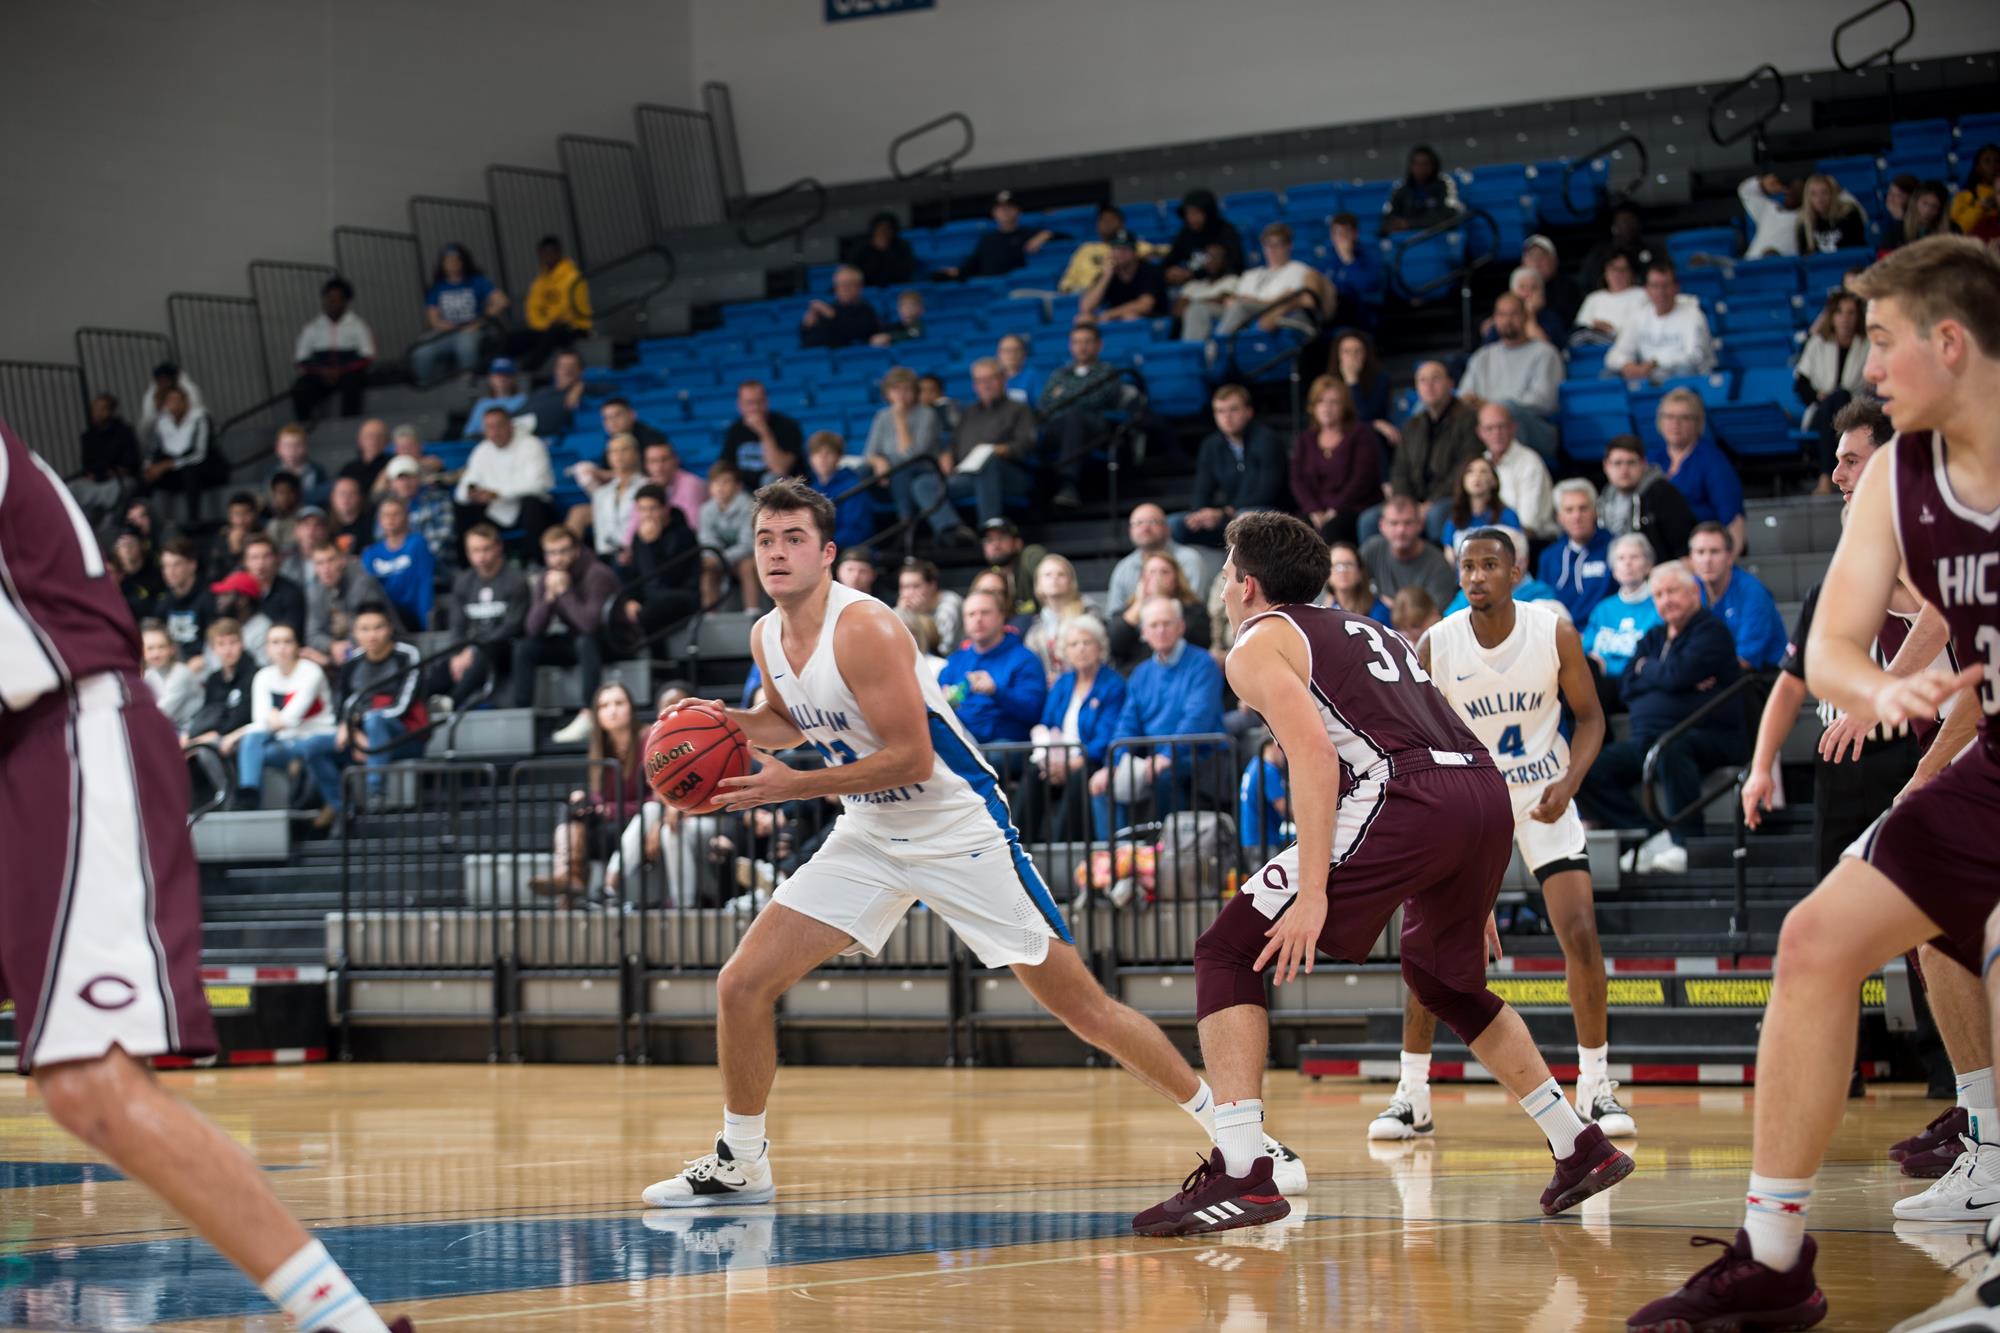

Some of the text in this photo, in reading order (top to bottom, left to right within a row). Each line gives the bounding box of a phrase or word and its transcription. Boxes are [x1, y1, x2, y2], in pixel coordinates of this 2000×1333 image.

[1936, 551, 2000, 607] HIC
[1345, 620, 1431, 684] 32
[1465, 690, 1545, 720] MILLIKIN
[1497, 724, 1526, 758] 4
[663, 771, 703, 801] NCAA
